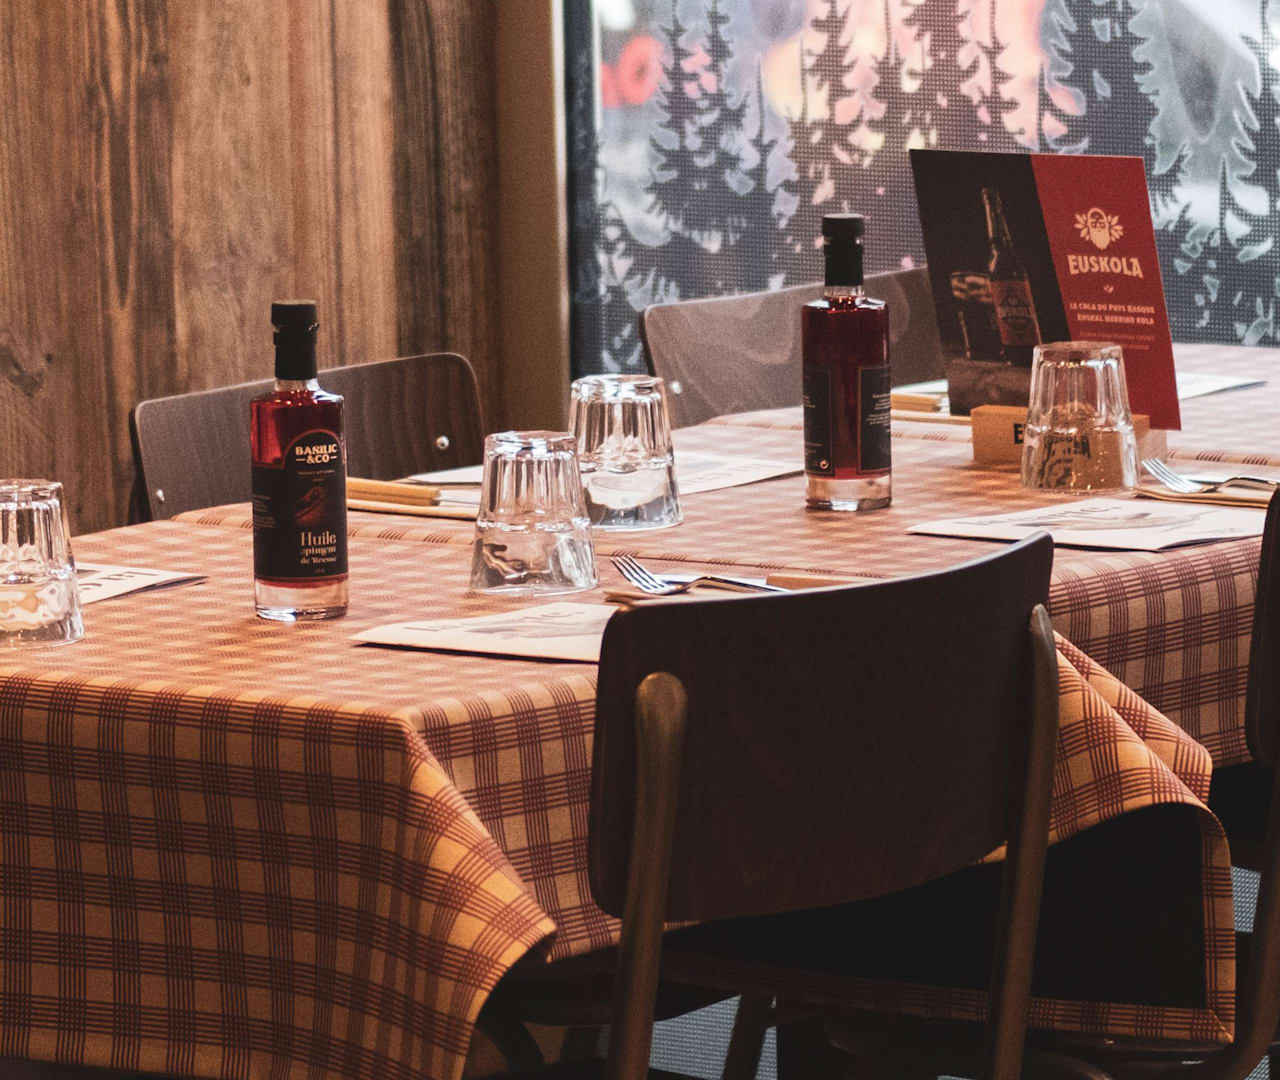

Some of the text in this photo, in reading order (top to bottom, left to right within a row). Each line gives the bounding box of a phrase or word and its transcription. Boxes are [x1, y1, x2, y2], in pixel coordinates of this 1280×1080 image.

[1067, 254, 1144, 279] EUSKOLA
[1079, 303, 1097, 311] COLA
[296, 443, 337, 455] BASILIC
[301, 530, 336, 546] Huile
